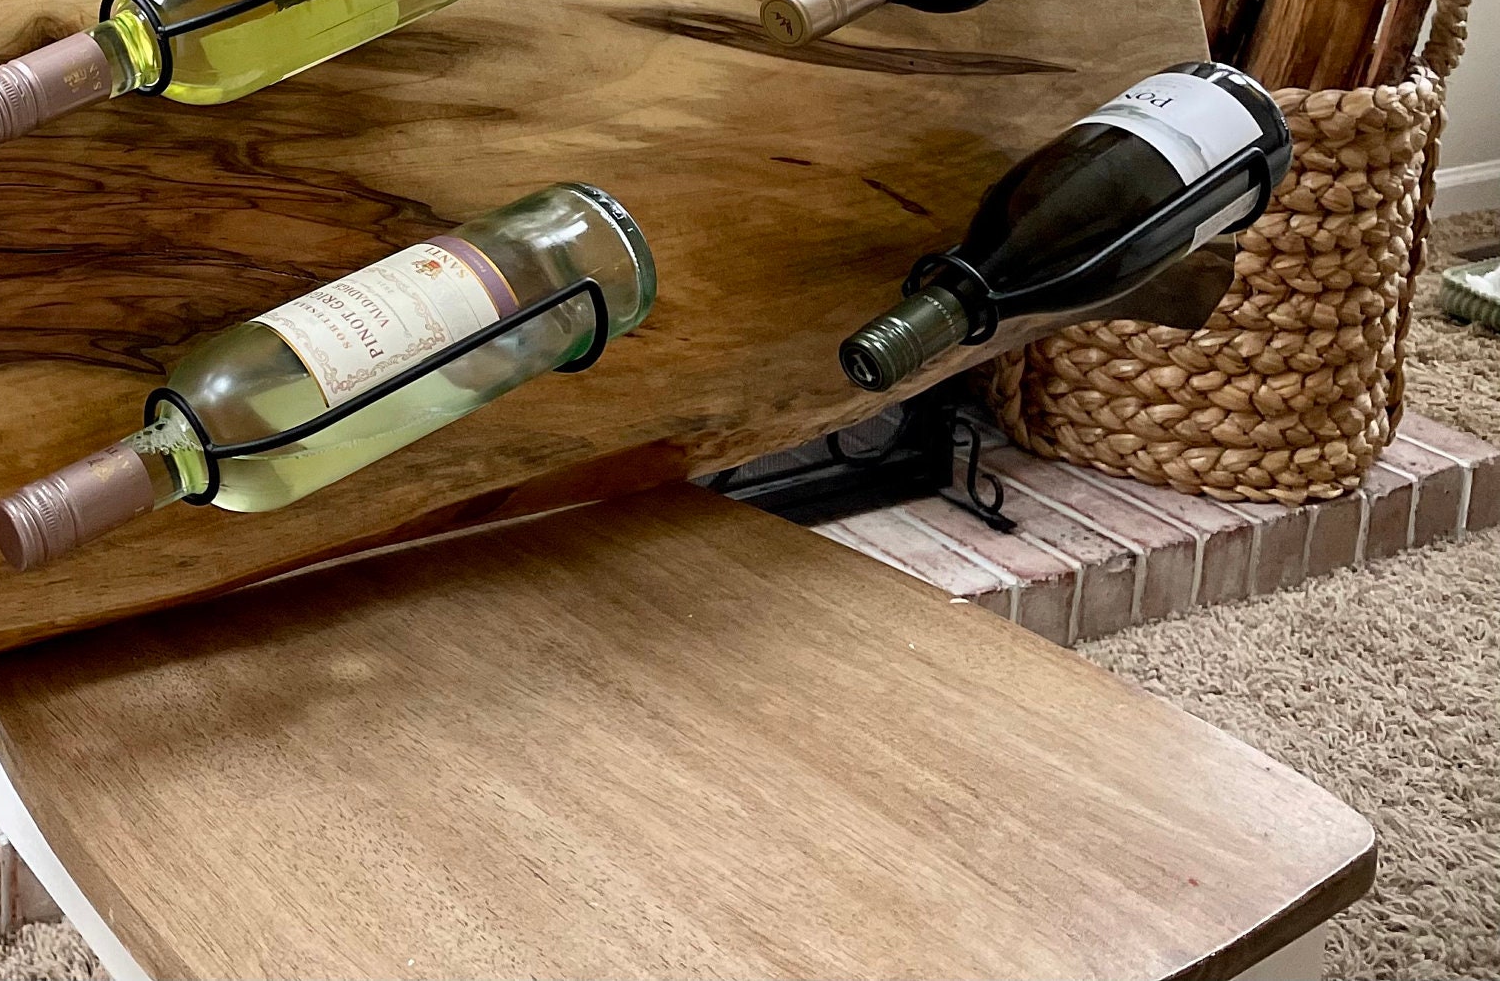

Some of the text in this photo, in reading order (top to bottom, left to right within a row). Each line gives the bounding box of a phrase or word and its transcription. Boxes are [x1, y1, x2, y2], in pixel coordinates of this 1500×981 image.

[424, 246, 470, 279] SANTI
[331, 282, 390, 329] VALDADIGE
[341, 312, 385, 360] PINOT
